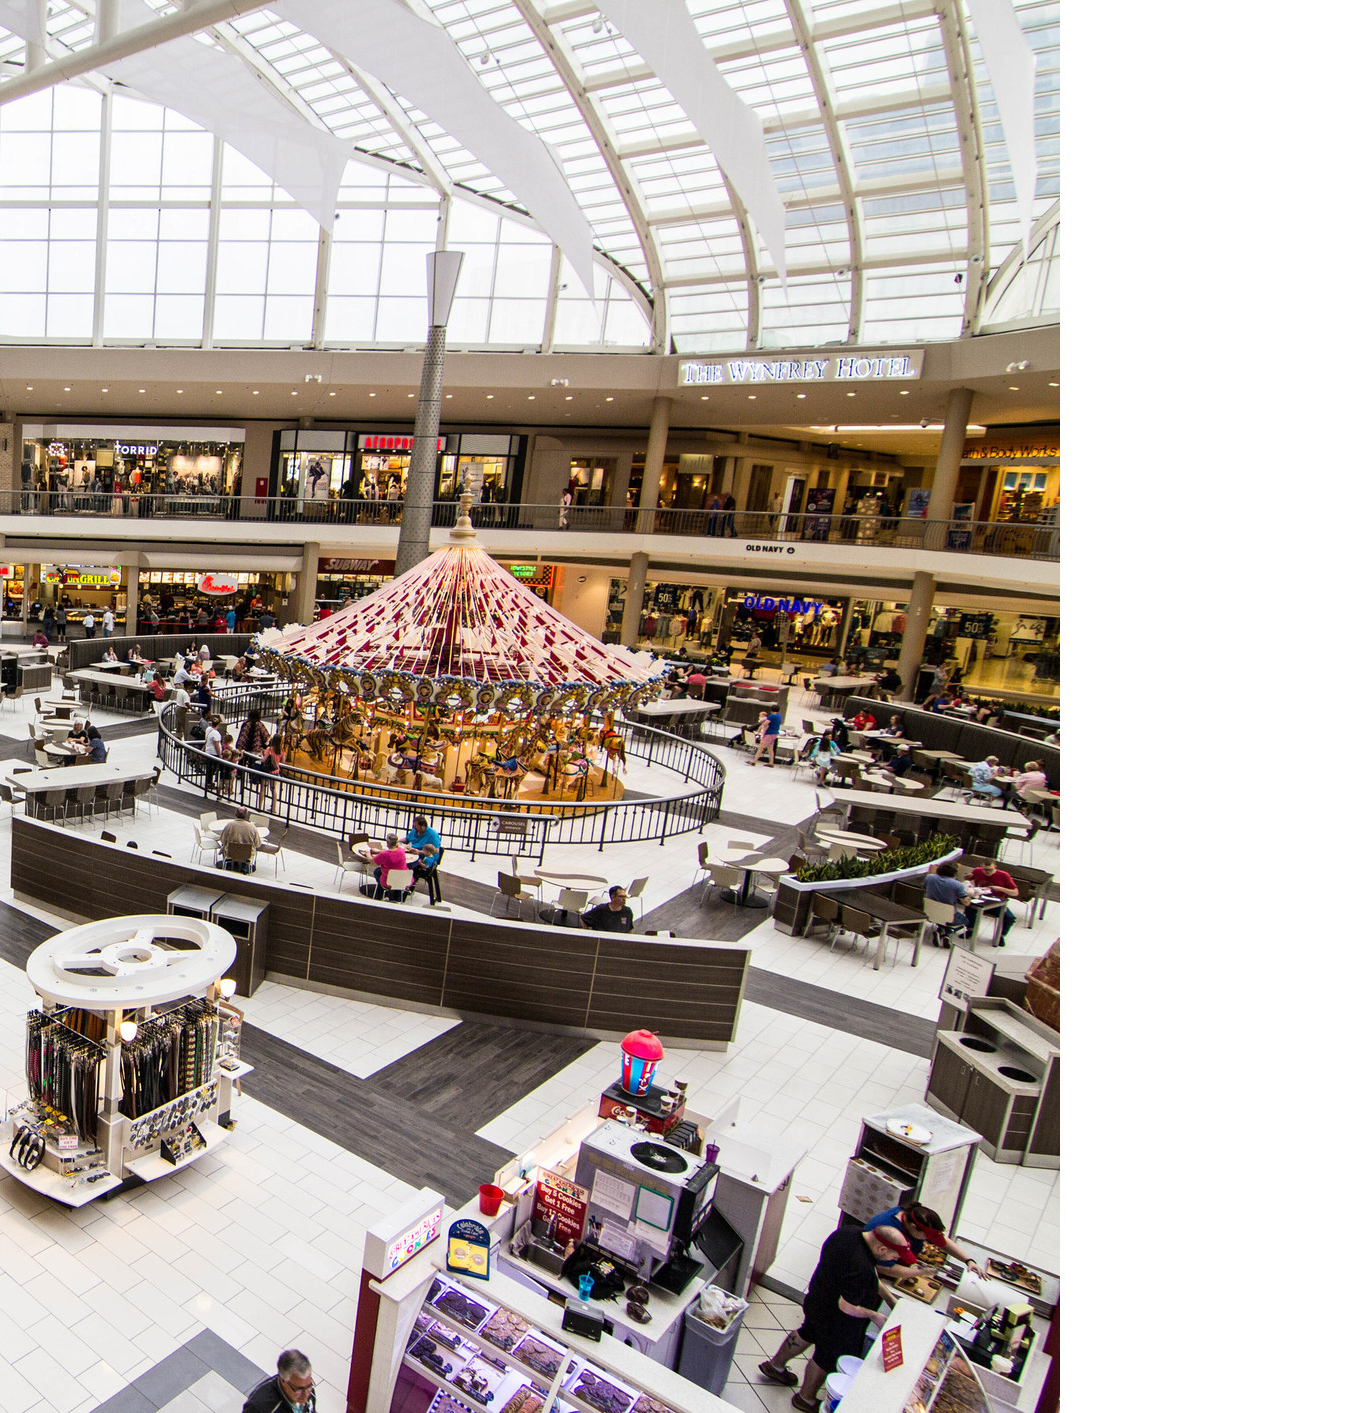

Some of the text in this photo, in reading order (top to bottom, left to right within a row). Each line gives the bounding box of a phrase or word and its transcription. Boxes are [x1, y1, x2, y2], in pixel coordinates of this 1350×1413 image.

[682, 355, 916, 384] THE WYNFREY HOTEL
[990, 446, 1018, 460] Body
[1020, 445, 1058, 458] Works
[324, 558, 380, 571] SUBWAY
[80, 574, 110, 584] GRILL
[744, 596, 824, 614] OLD NAVY
[541, 1184, 552, 1196] Buy
[558, 1192, 582, 1209] Cookies
[544, 1195, 556, 1205] Get
[562, 1203, 574, 1214] Free
[537, 1202, 548, 1214] Buy
[558, 1213, 580, 1230] Cookies
[558, 1222, 572, 1234] Free
[392, 1226, 436, 1268] COOKIES
